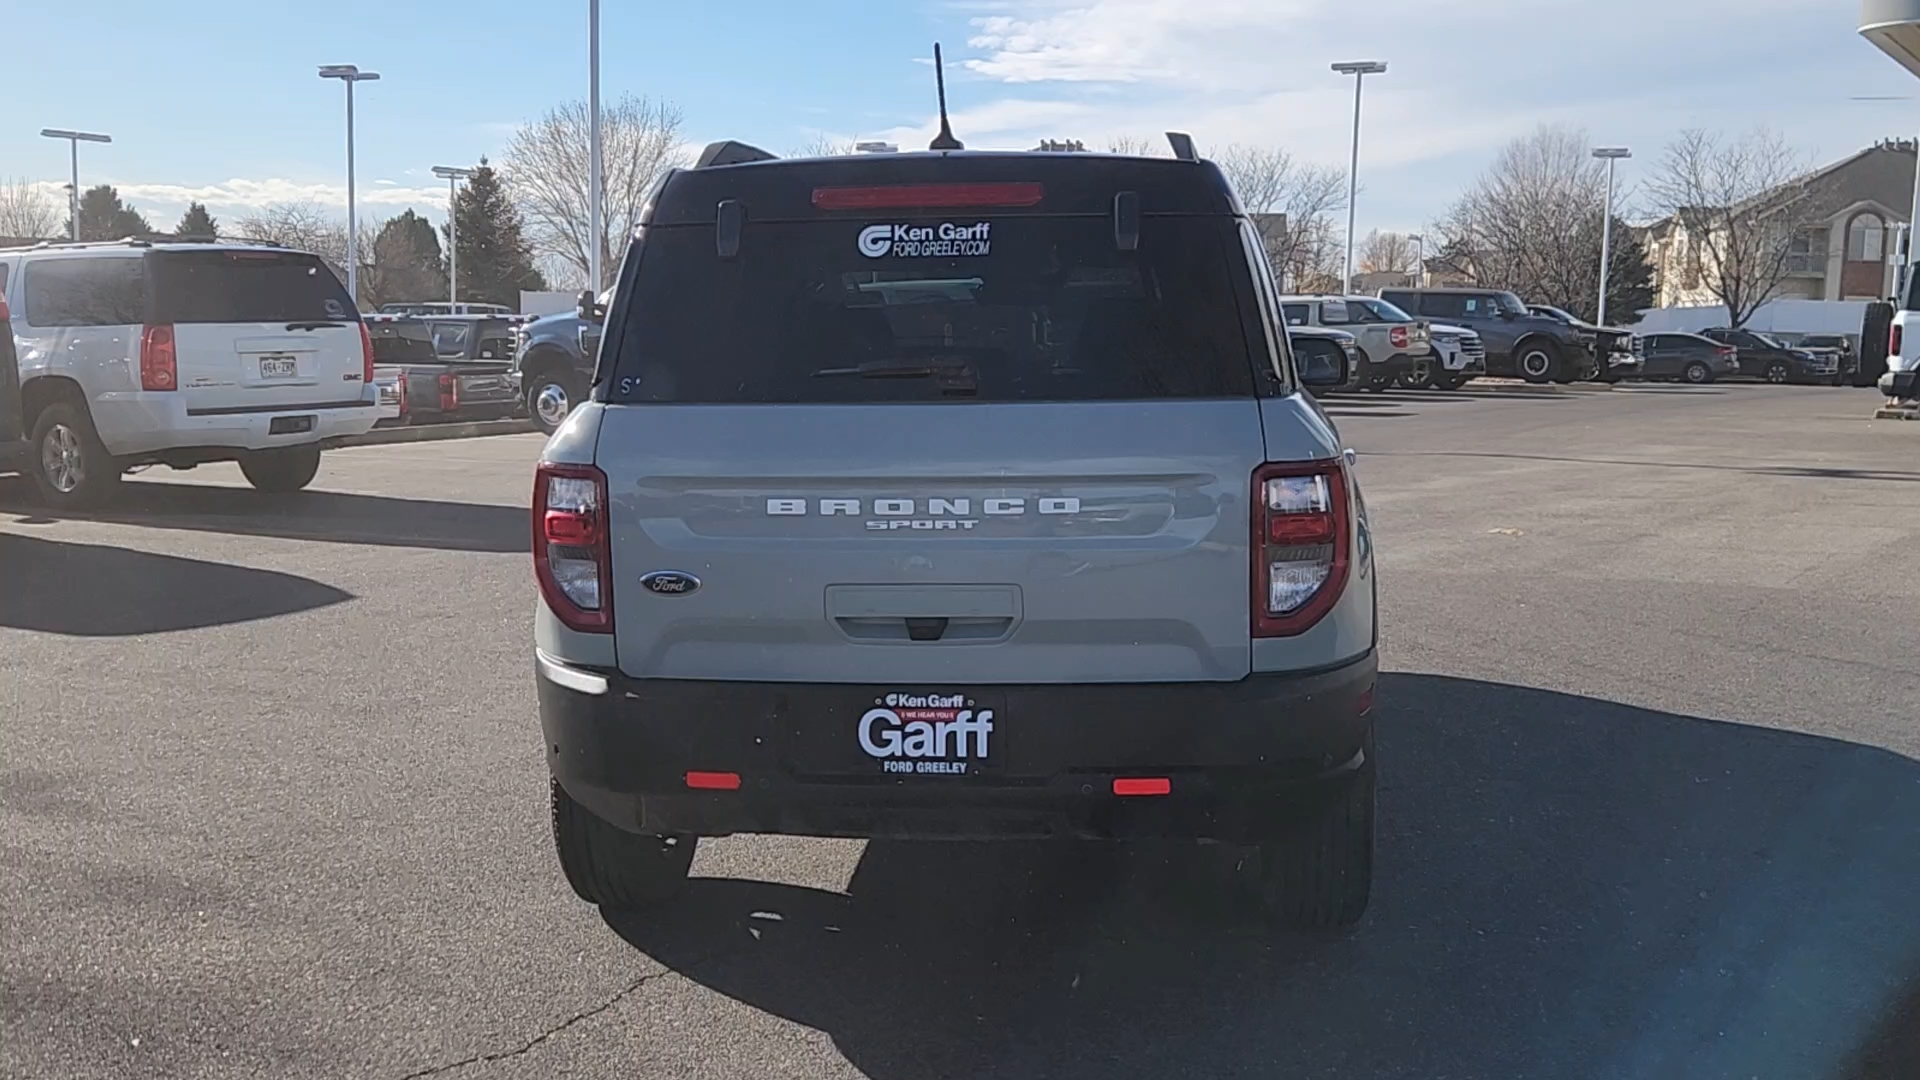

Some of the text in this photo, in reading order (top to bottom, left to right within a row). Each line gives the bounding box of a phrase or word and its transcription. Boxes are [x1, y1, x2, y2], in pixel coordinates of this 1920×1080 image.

[894, 224, 933, 241] Ken
[938, 223, 990, 240] Garff
[893, 241, 990, 257] FORD GREELEY.COM
[767, 498, 1080, 515] BRONCO
[866, 519, 979, 530] SPORT
[652, 576, 686, 592] Ford
[899, 693, 926, 707] Ken
[927, 694, 964, 708] Garff
[858, 708, 994, 758] Garff
[883, 761, 967, 774] FORD GREELEY
